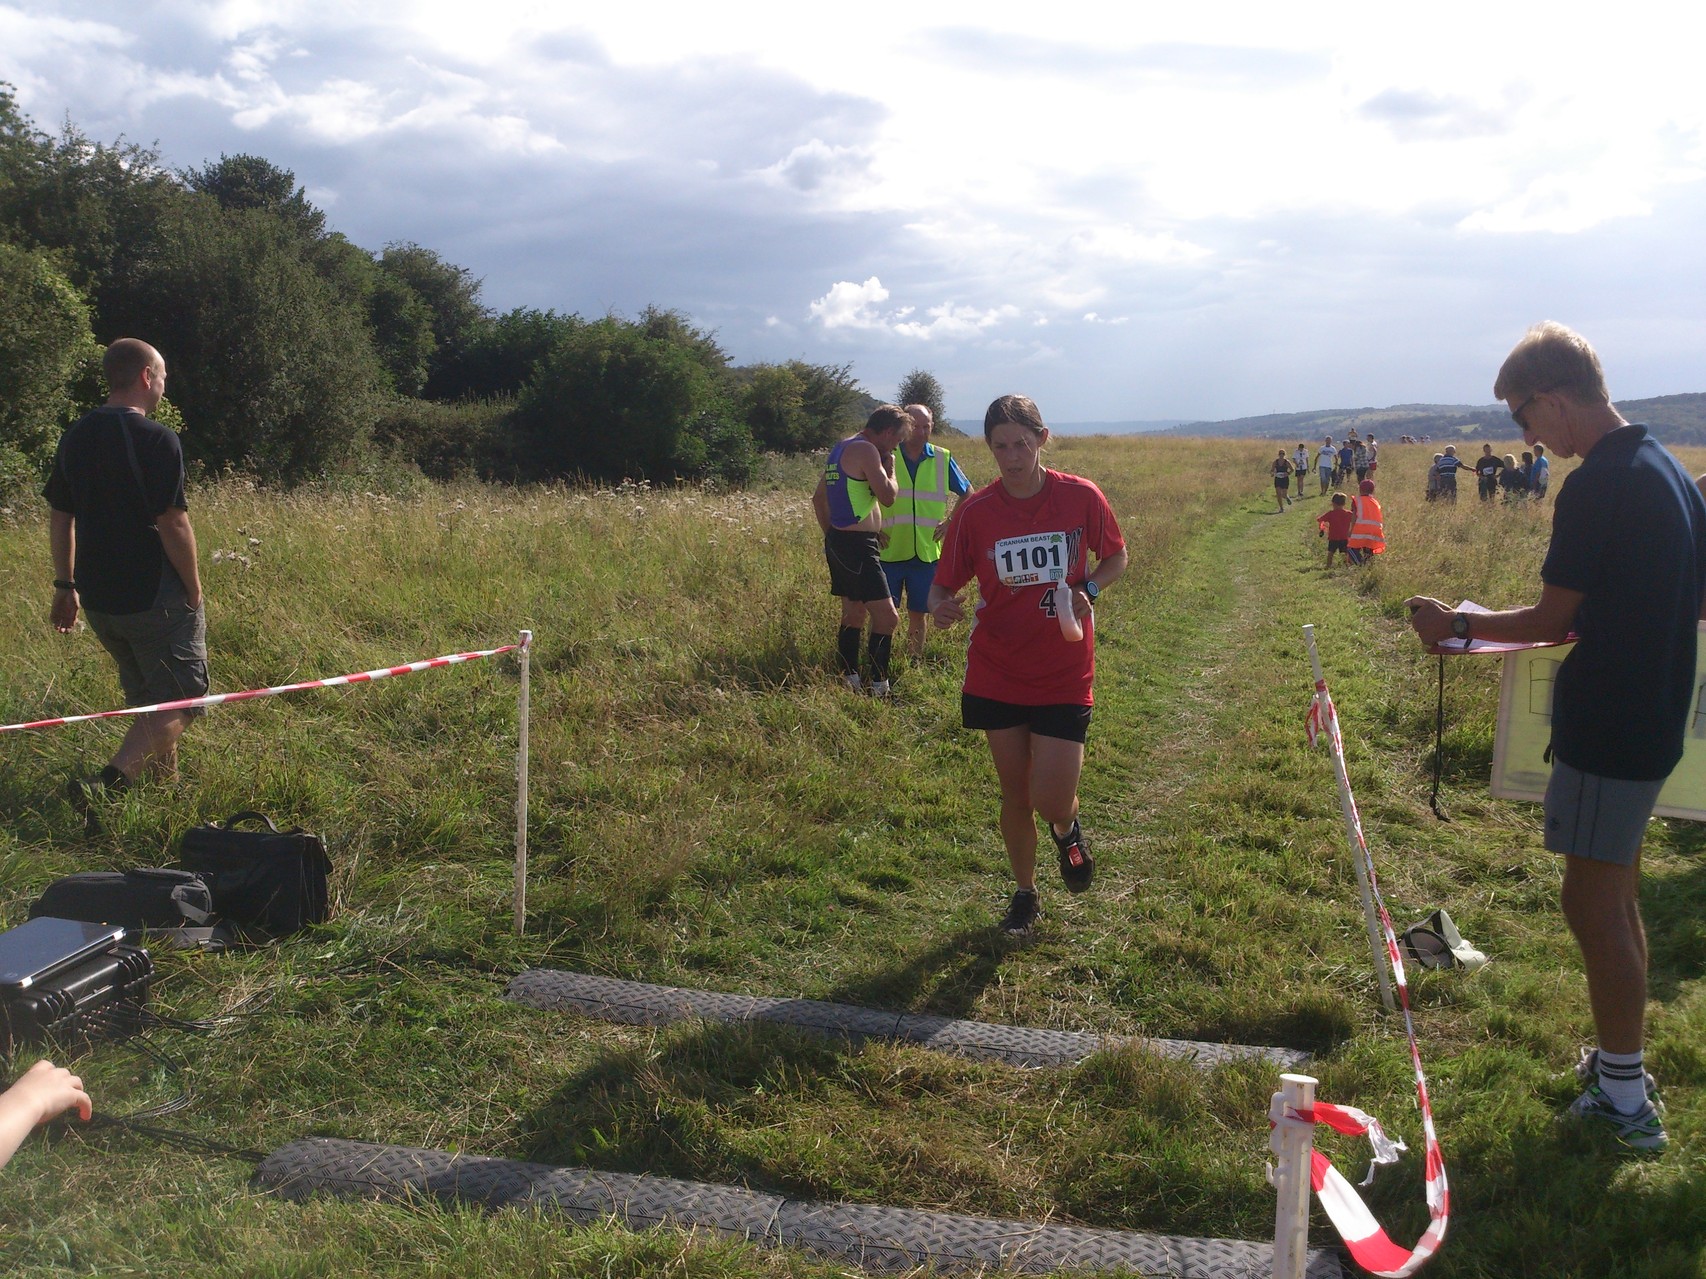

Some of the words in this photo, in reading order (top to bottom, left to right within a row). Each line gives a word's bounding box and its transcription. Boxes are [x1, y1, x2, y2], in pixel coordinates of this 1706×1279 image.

[999, 538, 1029, 547] CRANHAM
[1030, 535, 1051, 543] BEAST
[1001, 544, 1060, 573] 1101
